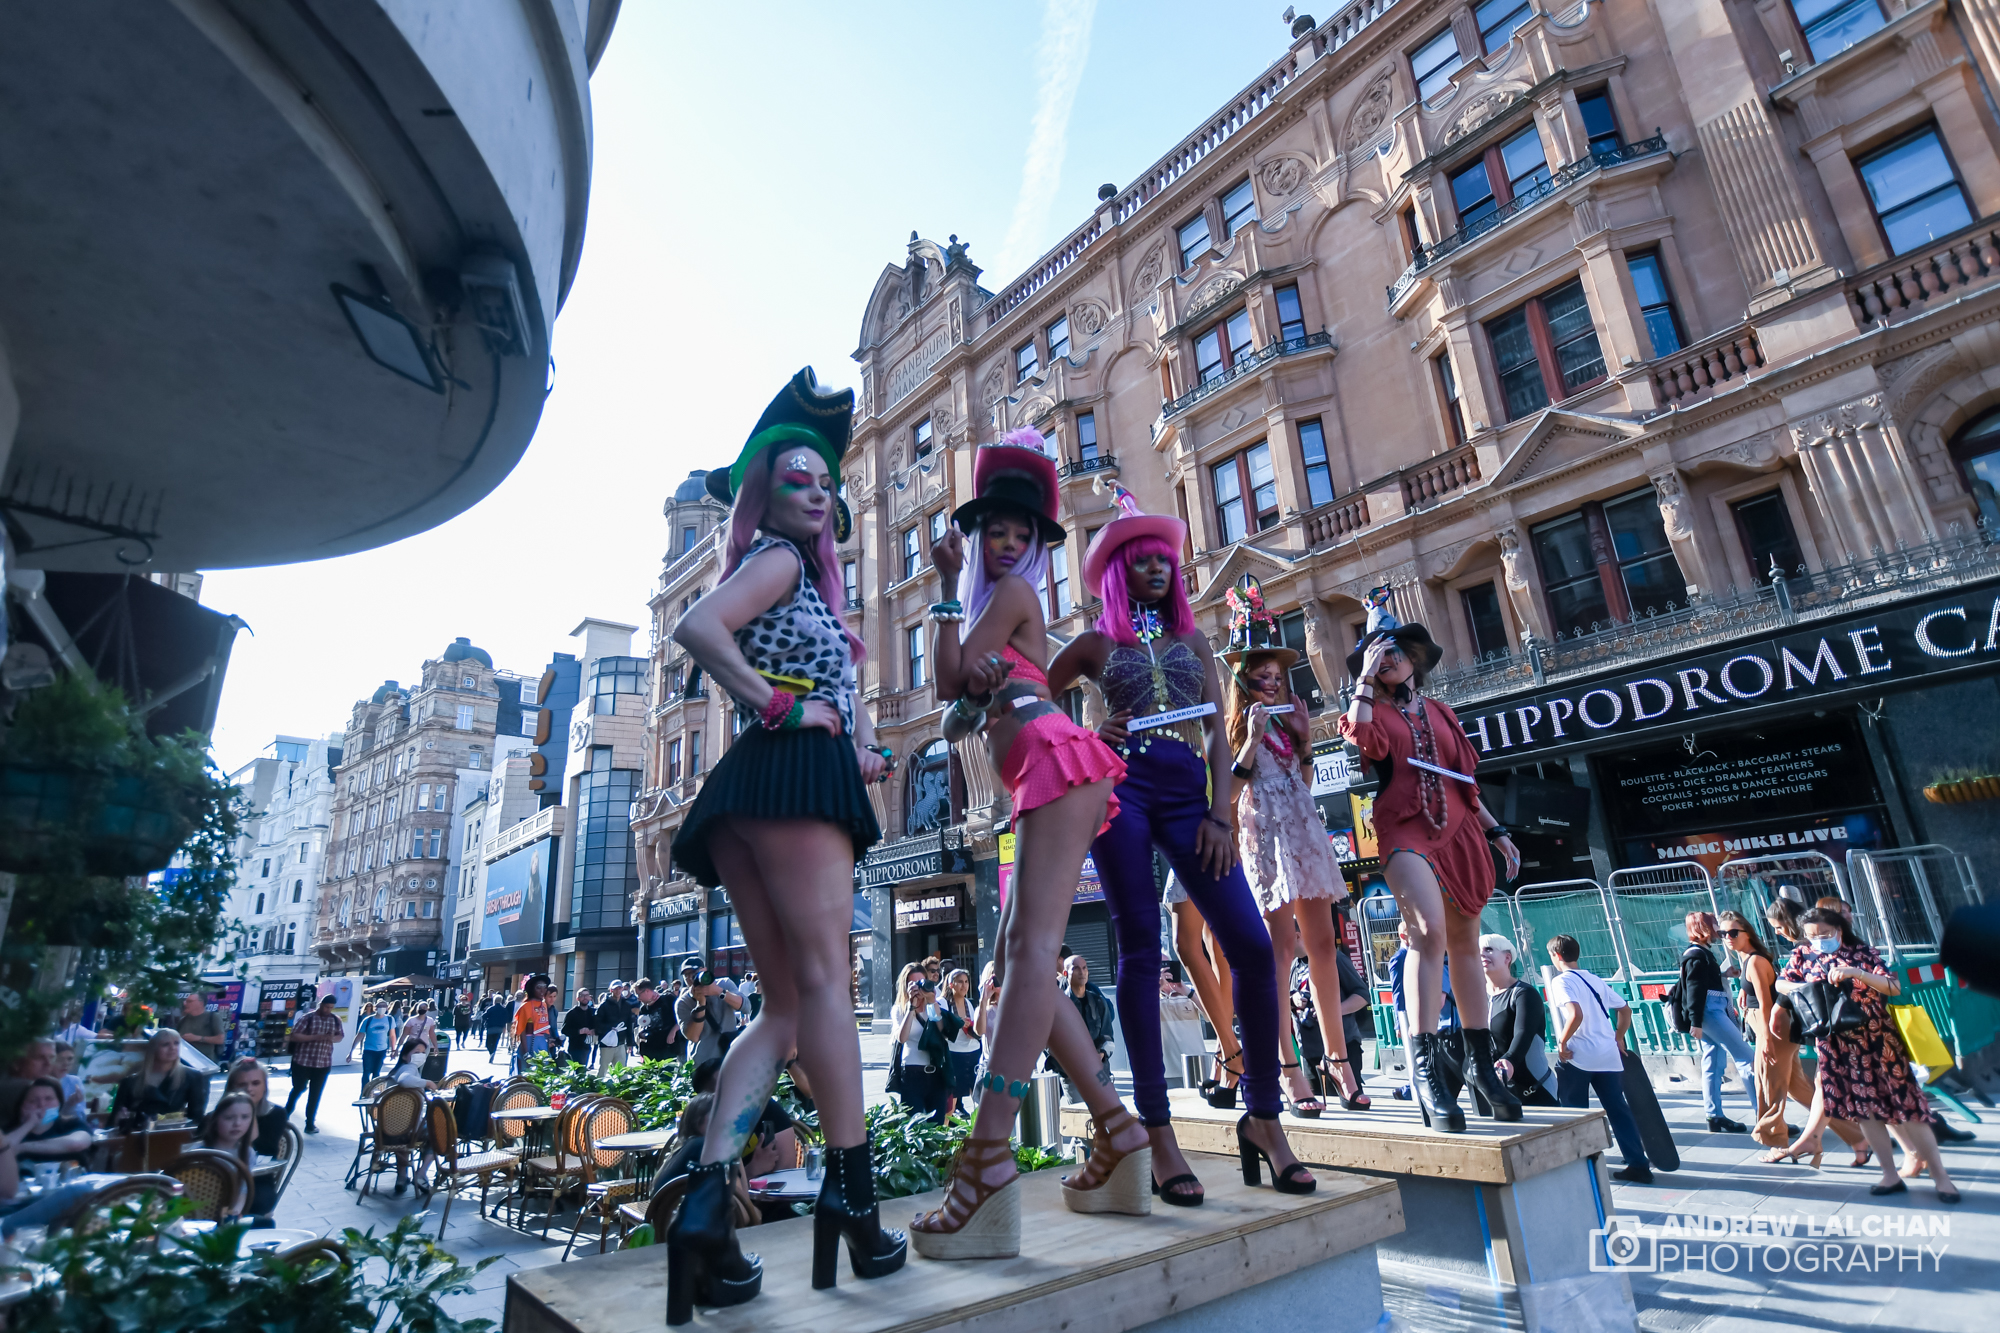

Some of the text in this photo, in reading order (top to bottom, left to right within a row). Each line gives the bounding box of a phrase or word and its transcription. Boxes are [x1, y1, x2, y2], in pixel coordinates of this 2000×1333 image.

[1458, 625, 1892, 752] HIPPODROME
[1620, 743, 1842, 787] ROULETTE BLACKJACK BACCARAT STEAKS
[1647, 760, 1814, 793] SLOTS DICE DRAMA FEATHERS
[1641, 769, 1828, 804] COCKTAILS SONG & DANCE CIGARS
[1661, 783, 1813, 812] POKER WHISKY ADVENTURE
[1656, 826, 1849, 860] MAGIC MIKE LIVE
[864, 856, 937, 884] HIPPODROME
[650, 900, 694, 918] HIPPODROME
[909, 911, 930, 922] LIVE
[921, 896, 955, 910] MIKE
[263, 982, 299, 991] WEST END
[264, 991, 297, 999] FOODS
